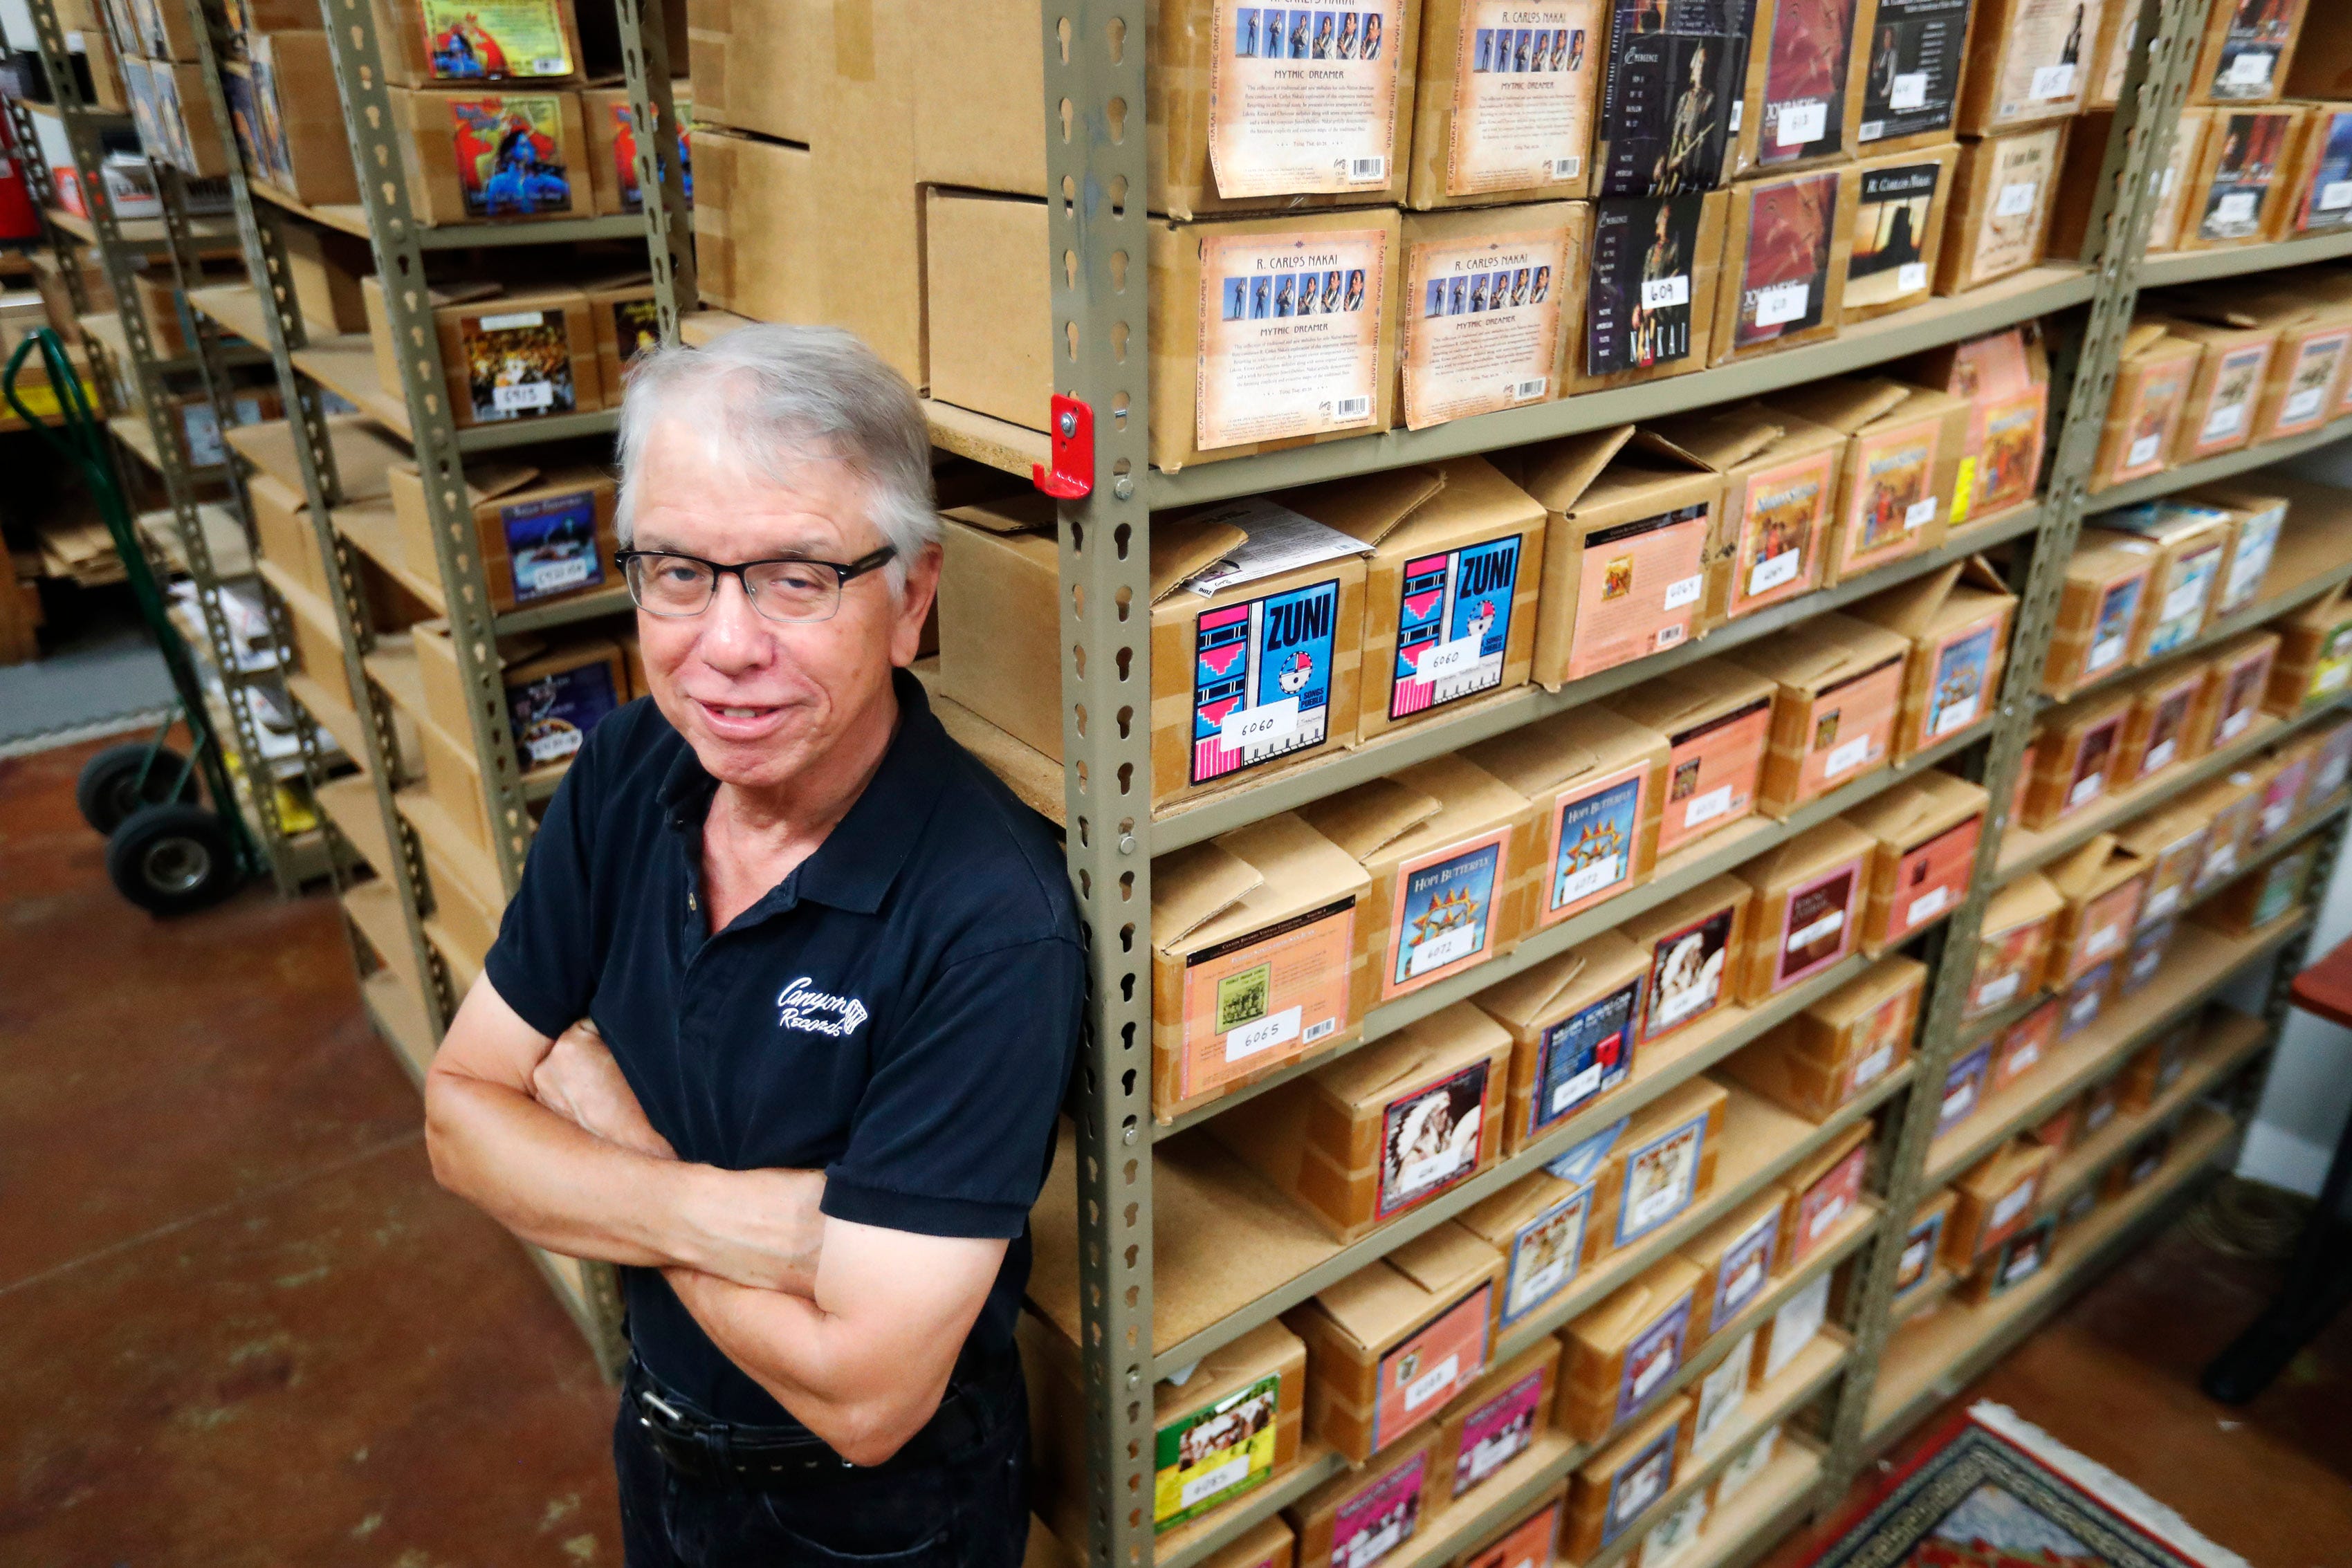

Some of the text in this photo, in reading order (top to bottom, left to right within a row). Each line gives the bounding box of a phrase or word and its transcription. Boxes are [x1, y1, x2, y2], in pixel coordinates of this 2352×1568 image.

[1503, 12, 1566, 24] R. CARLOS NAKAI
[1274, 70, 1344, 80] MYTHIC DREAMER
[1527, 81, 1554, 90] DREAMER
[1257, 254, 1338, 270] R. CARLOS NAKAI
[1455, 253, 1528, 270] R. CARLOS NAKAI
[1651, 284, 1673, 302] 609
[1260, 324, 1328, 337] MYTHIC DREAMER
[1456, 315, 1516, 331] MYTHIC DREAMER
[1460, 547, 1514, 600] ZUNI
[1267, 593, 1331, 652] ZUNI
[1433, 652, 1458, 667] 6060
[1303, 687, 1324, 700] SONGS
[1301, 696, 1323, 708] PUEBLO
[1242, 719, 1274, 735] 6060
[1415, 857, 1489, 892] HOPI BUTTERFLY
[778, 977, 847, 1015] Canyon
[1245, 1024, 1279, 1046] 6065
